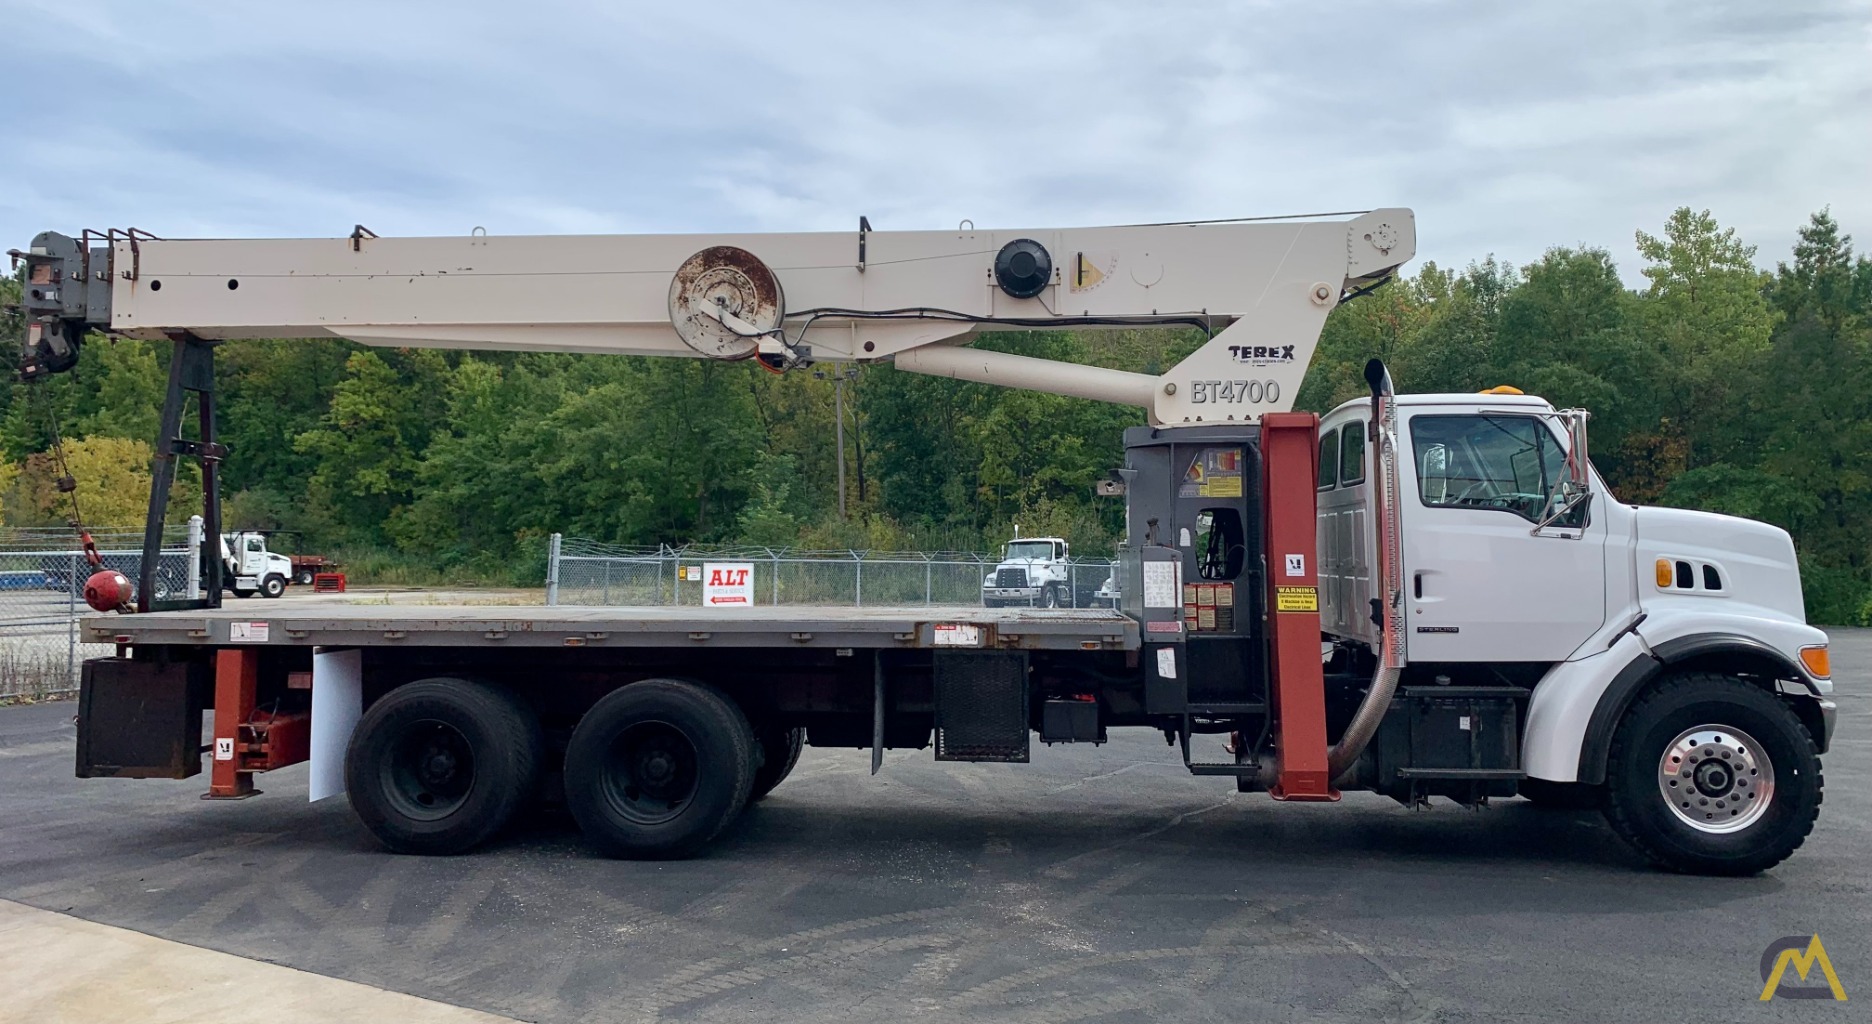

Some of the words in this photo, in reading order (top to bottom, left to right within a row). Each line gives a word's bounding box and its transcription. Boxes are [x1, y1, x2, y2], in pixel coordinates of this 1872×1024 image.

[1228, 345, 1295, 360] TEREX
[1191, 379, 1280, 403] BT4700
[709, 570, 749, 586] ALT
